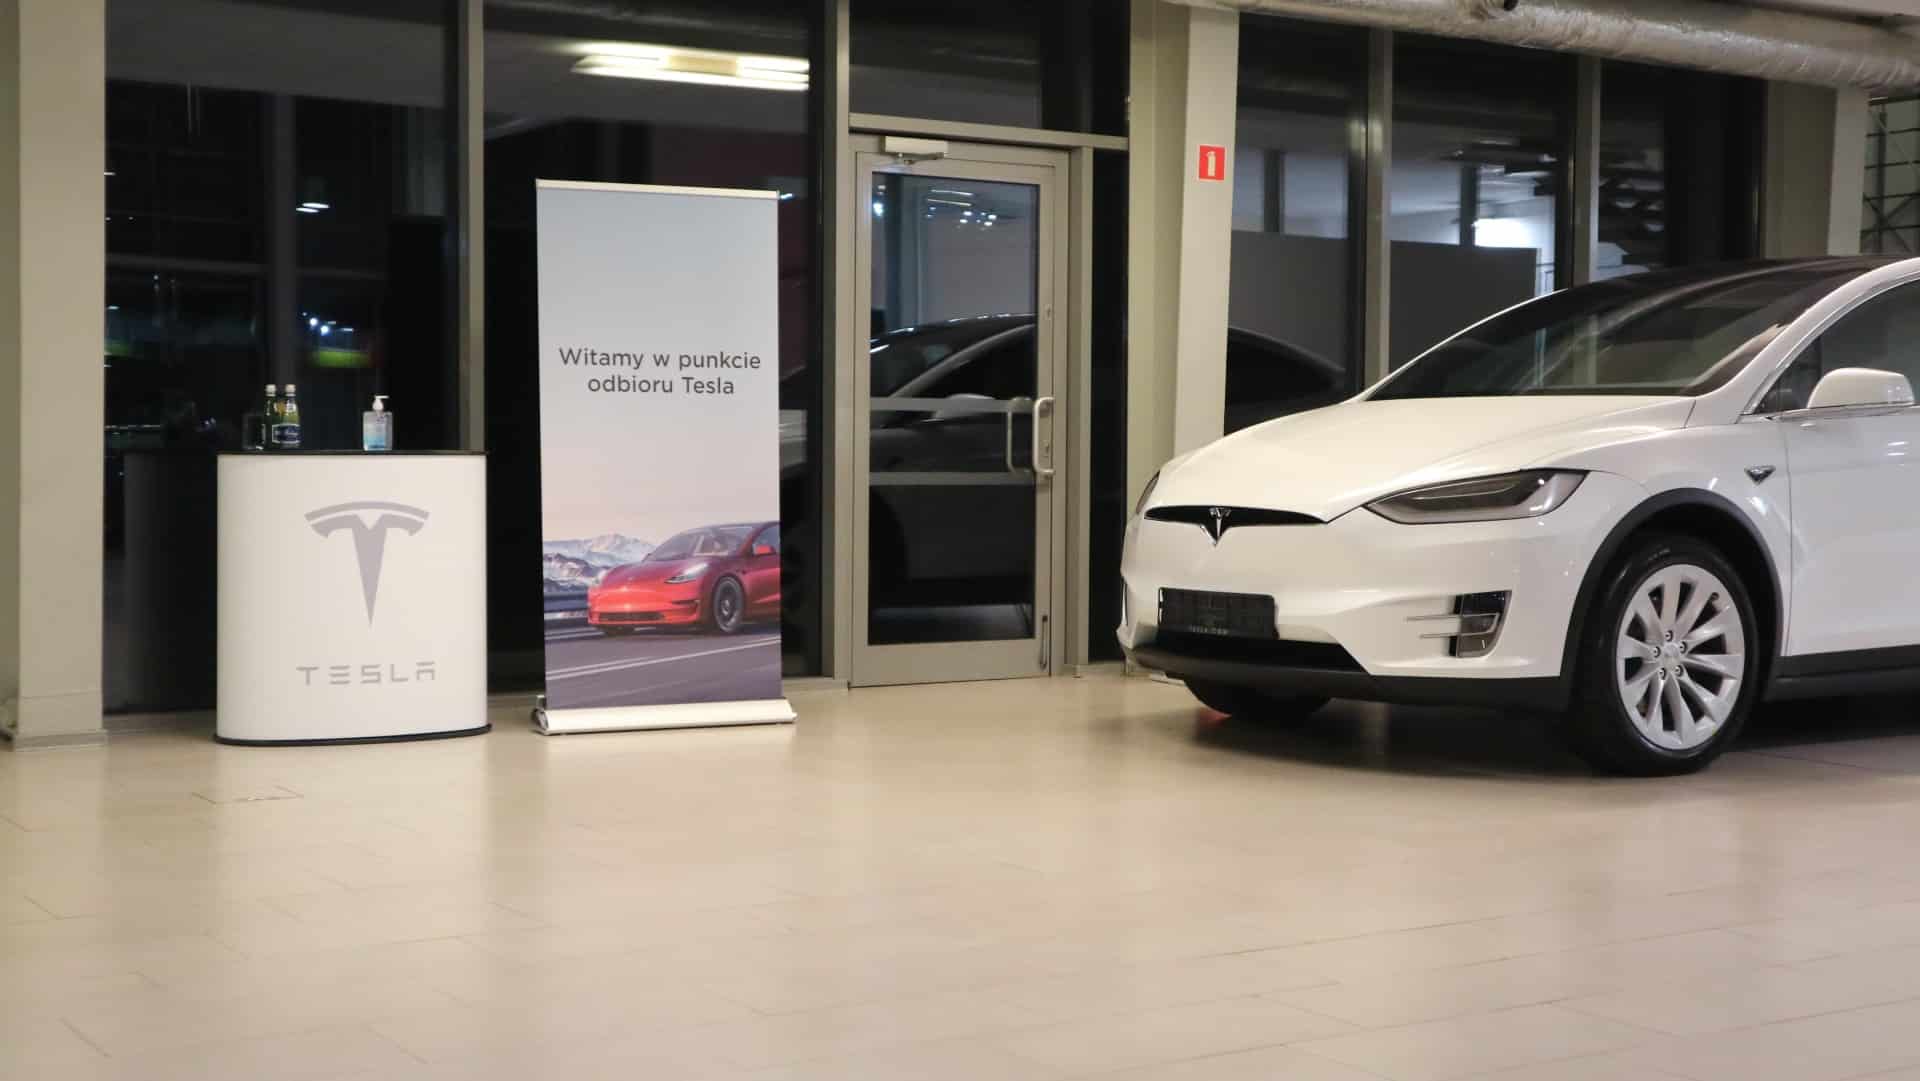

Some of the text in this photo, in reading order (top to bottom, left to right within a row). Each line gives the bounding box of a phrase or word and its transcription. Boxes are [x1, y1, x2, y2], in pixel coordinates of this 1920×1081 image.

[559, 347, 761, 371] Witamy w punkcie
[588, 375, 735, 395] odbioru Tesla
[295, 660, 436, 687] TESLA
